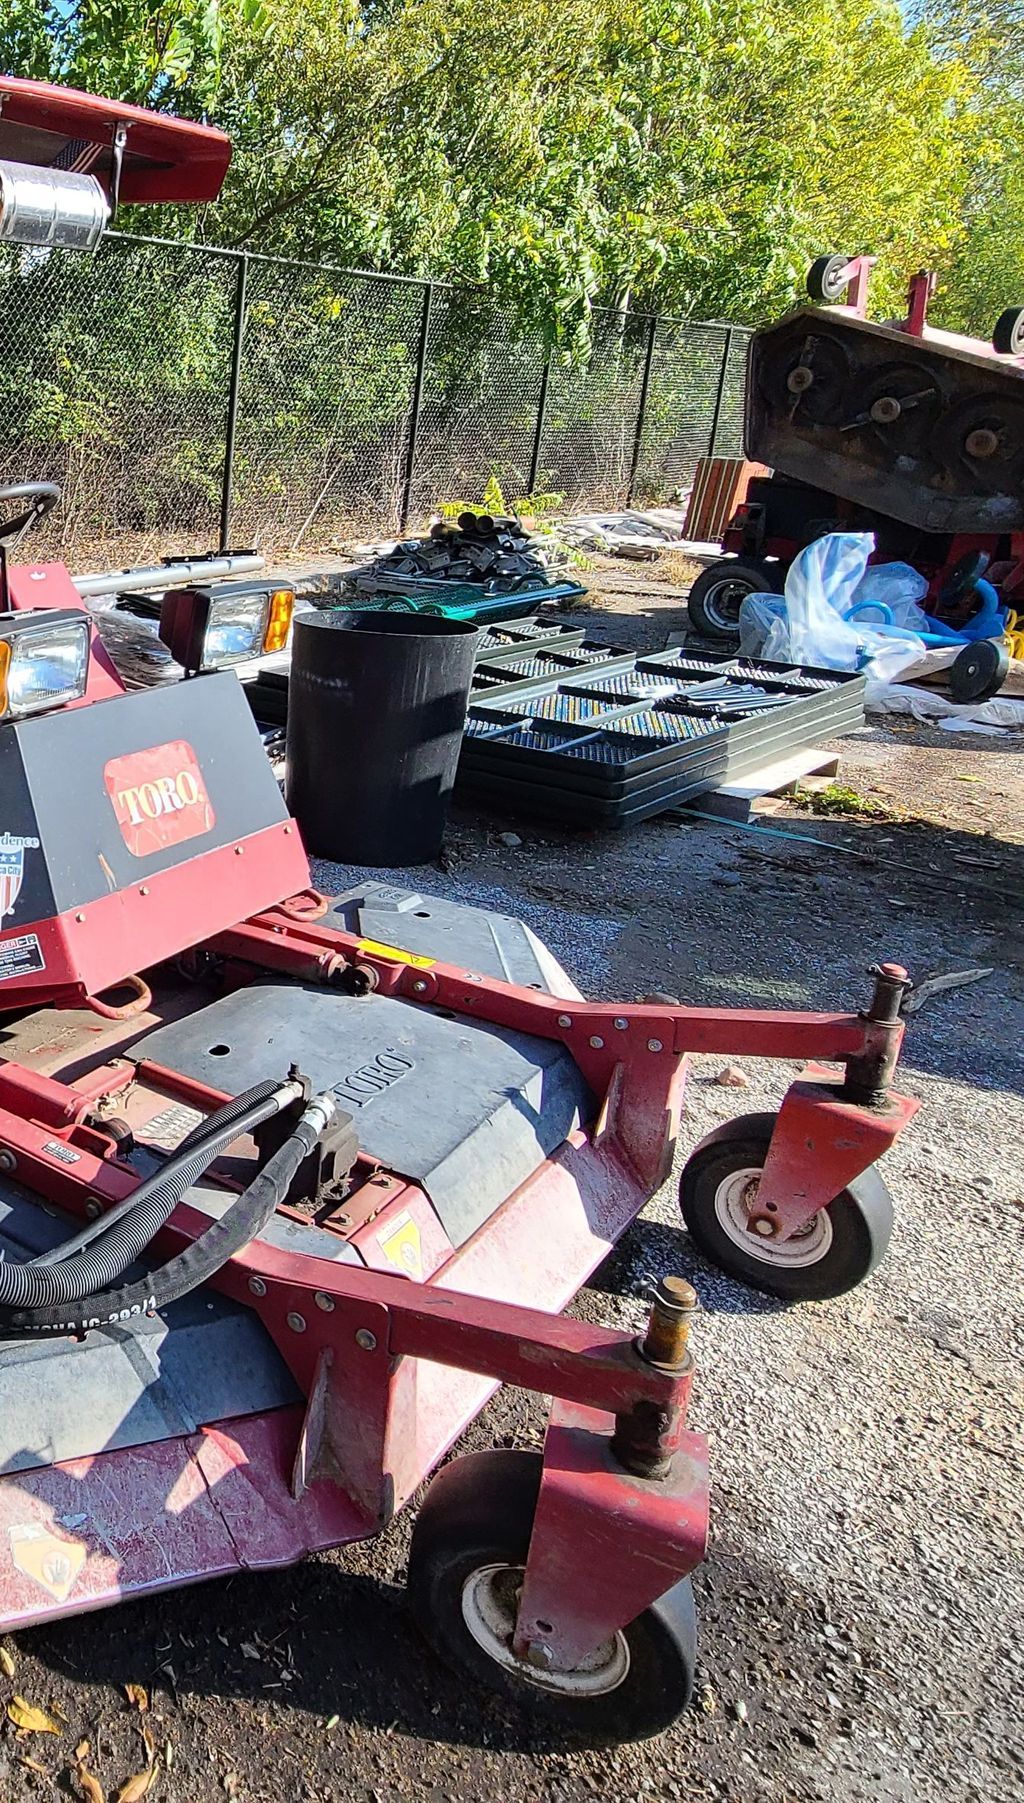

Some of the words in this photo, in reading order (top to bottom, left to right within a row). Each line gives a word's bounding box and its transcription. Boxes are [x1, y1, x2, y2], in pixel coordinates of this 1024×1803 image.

[118, 771, 199, 825] TORO
[8, 866, 21, 876] City
[317, 1053, 414, 1107] TORO
